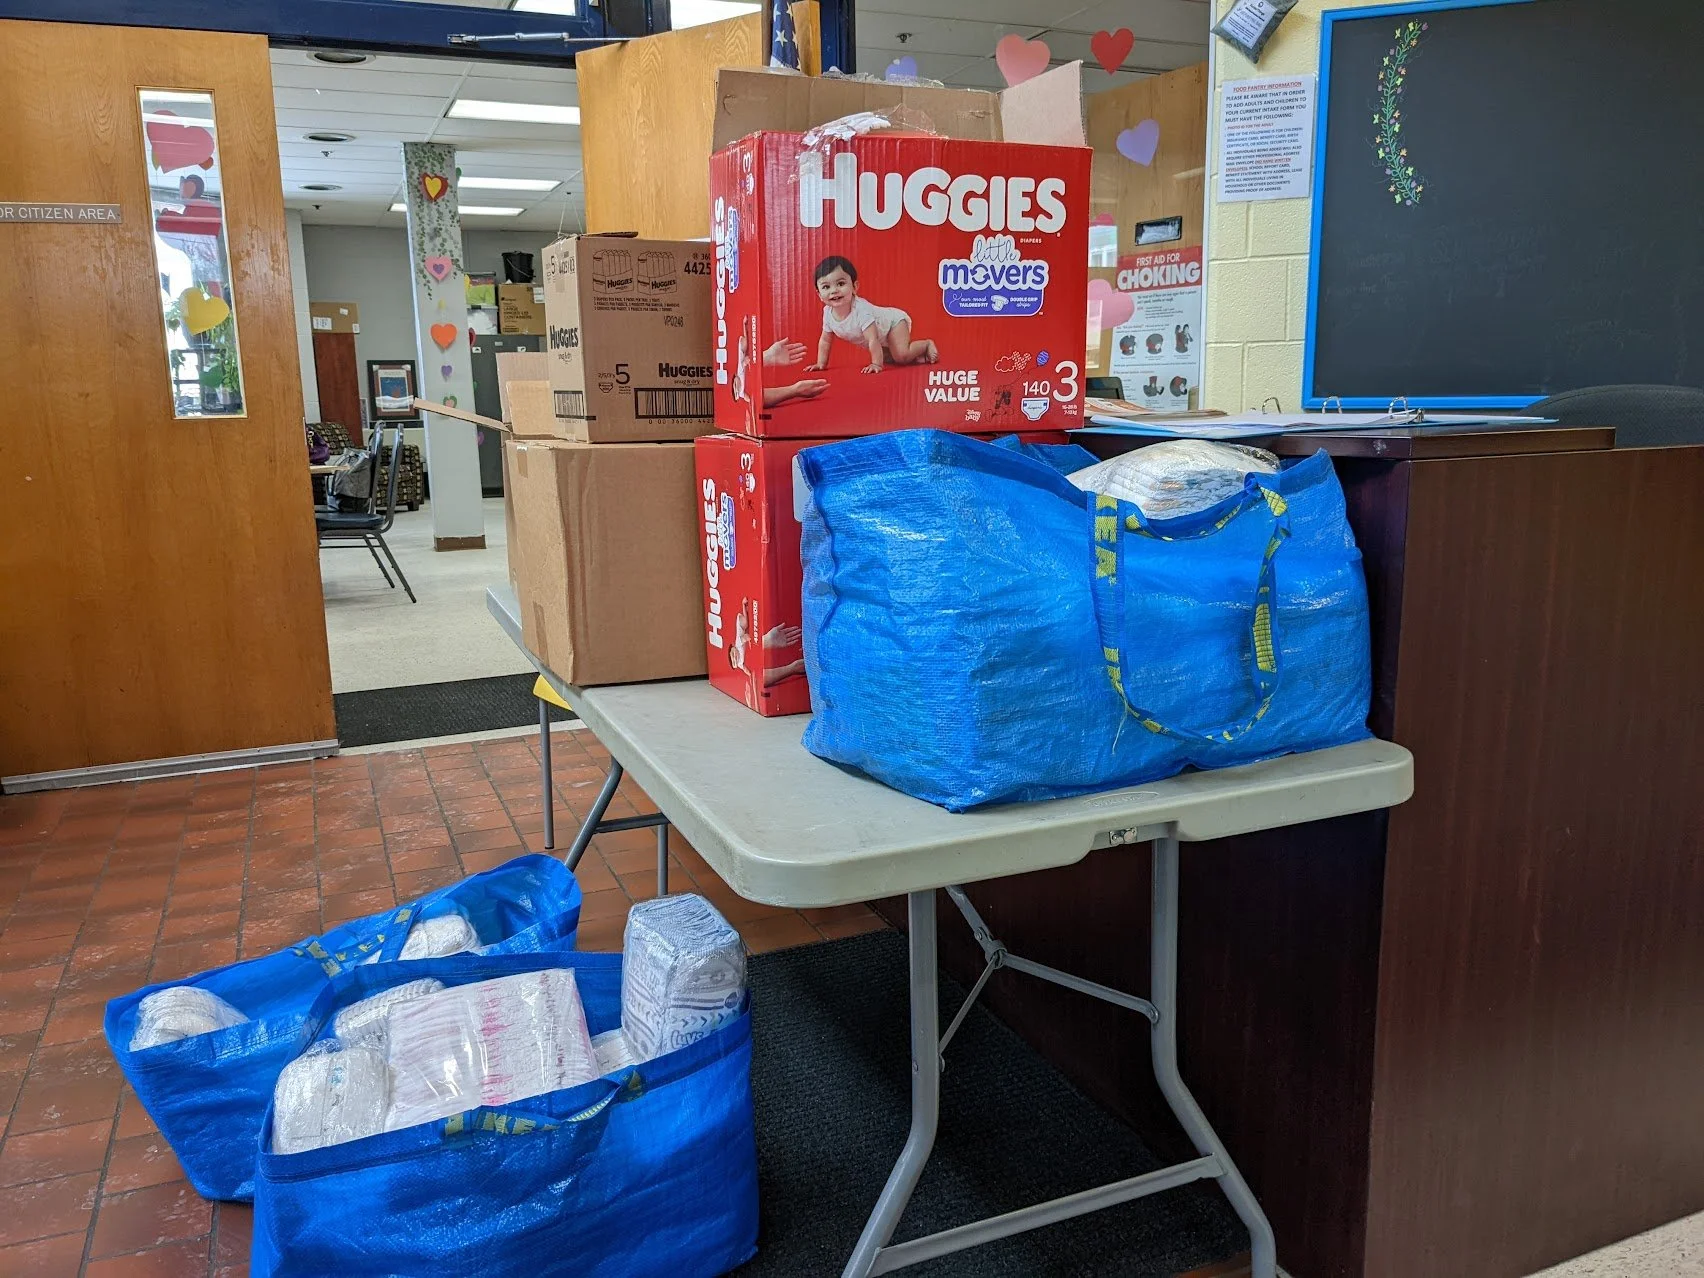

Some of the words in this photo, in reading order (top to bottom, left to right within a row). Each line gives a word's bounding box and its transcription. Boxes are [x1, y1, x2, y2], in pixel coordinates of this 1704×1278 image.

[1267, 82, 1302, 90] INFORMATION
[742, 152, 751, 173] 3
[800, 152, 1066, 233] HUGGIES
[18, 207, 74, 220] CITIZEN
[78, 208, 116, 220] AREA
[974, 239, 1017, 263] little
[1136, 256, 1153, 267] FIRST
[1154, 255, 1165, 264] AID
[1166, 253, 1180, 263] FOR
[607, 277, 633, 288] HUGGIES
[651, 279, 677, 289] HUGGIES
[942, 264, 1045, 285] movers
[1117, 261, 1200, 290] CHOKING
[714, 195, 728, 385] HUGGIES
[549, 325, 579, 350] HUGGIES
[615, 363, 631, 385] 5
[658, 363, 714, 378] HUGGIES
[929, 370, 979, 386] HUGE
[1052, 360, 1079, 402] 3
[924, 387, 981, 403] VALUE
[1022, 380, 1050, 396] 140
[740, 453, 751, 472] 3
[1095, 494, 1117, 578] EA
[702, 478, 724, 650] HUGGIES
